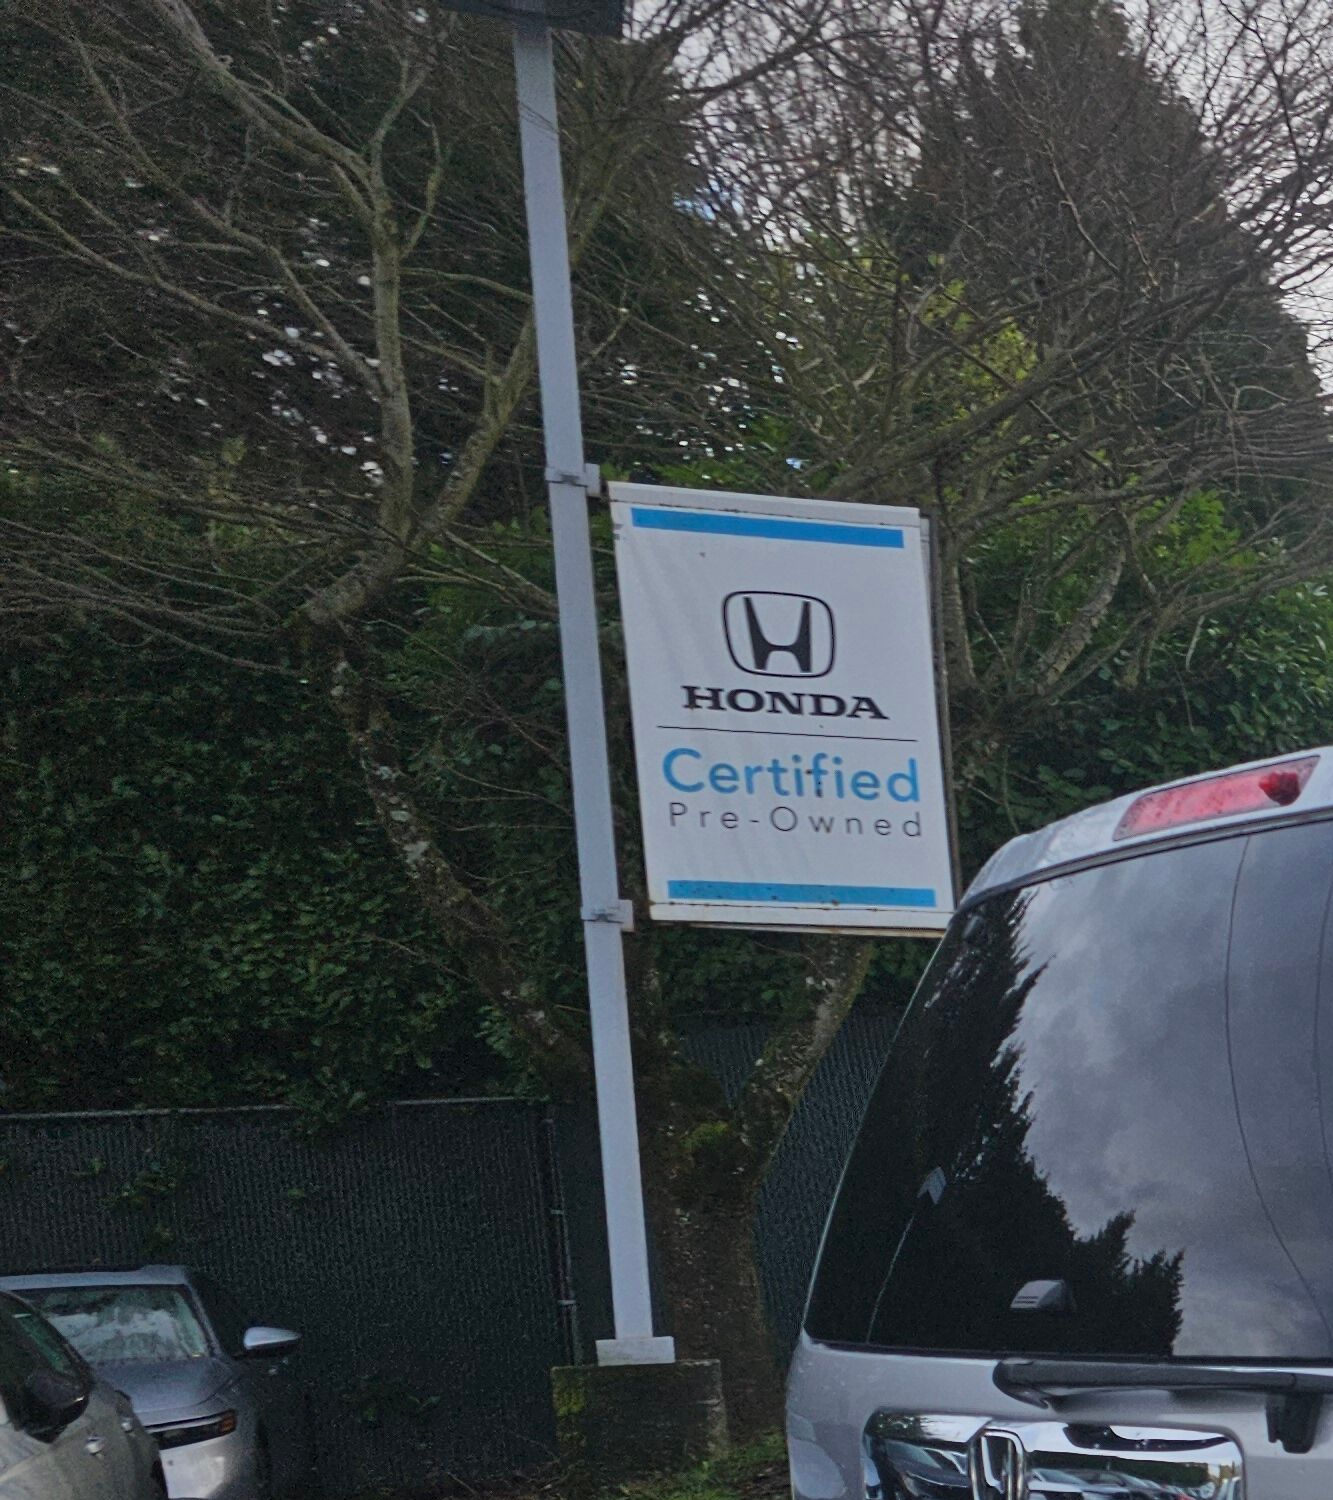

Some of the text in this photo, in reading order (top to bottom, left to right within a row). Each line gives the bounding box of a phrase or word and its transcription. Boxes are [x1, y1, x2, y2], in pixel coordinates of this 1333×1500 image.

[681, 685, 890, 720] HONDA
[662, 747, 920, 802] Certified
[670, 802, 922, 837] Pre-Owned
